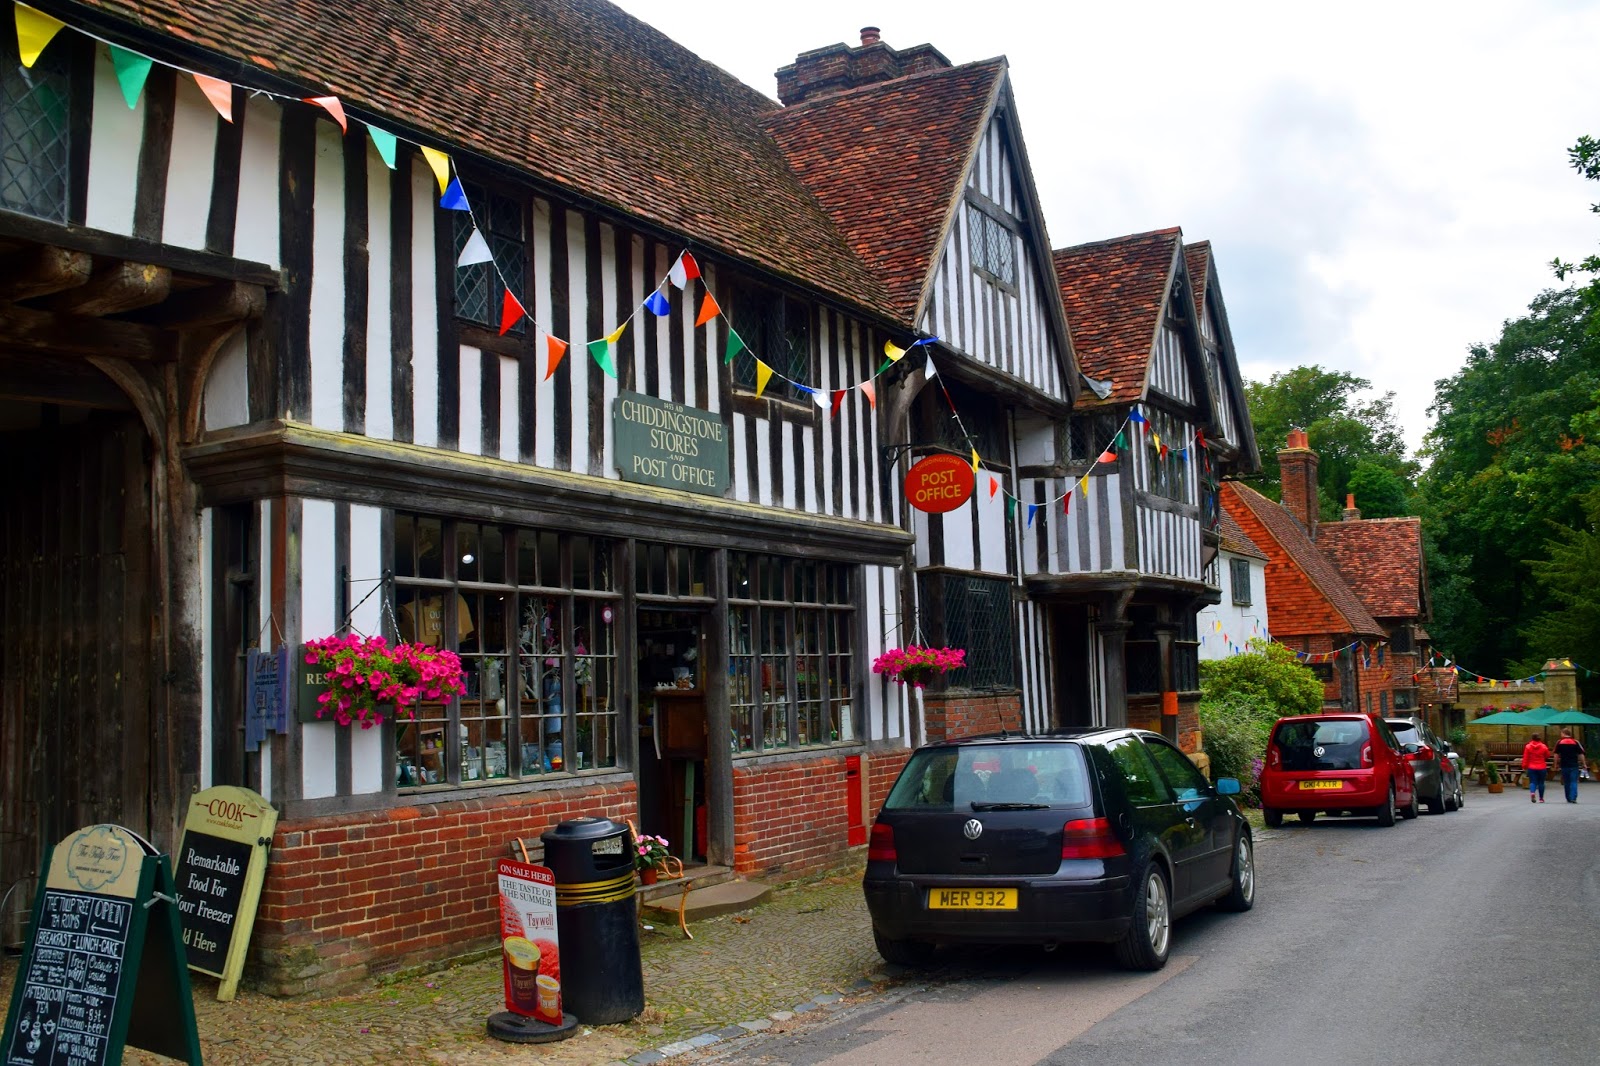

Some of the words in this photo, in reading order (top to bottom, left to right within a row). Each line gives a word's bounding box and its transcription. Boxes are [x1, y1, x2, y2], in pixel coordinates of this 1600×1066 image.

[622, 400, 722, 442] CHIDDINGSTONE
[650, 428, 698, 456] STORES
[633, 455, 667, 478] POST
[672, 464, 716, 487] OFFICE
[916, 456, 960, 472] CHIDDINGSTONE
[921, 470, 956, 486] POST
[916, 484, 962, 502] OFFICE
[306, 673, 330, 684] RES
[209, 798, 246, 822] COOK
[186, 848, 240, 876] Remarkable
[500, 864, 512, 874] ON
[512, 866, 530, 878] SALE
[531, 870, 552, 883] HERE
[188, 872, 210, 892] Food
[211, 878, 227, 898] For
[501, 879, 517, 890] THE
[518, 883, 540, 896] TASTE
[542, 888, 553, 898] OF
[47, 896, 59, 911] THE
[503, 888, 518, 900] THE
[520, 892, 552, 907] SUMMER
[940, 892, 970, 906] MER
[975, 891, 1006, 906] 932
[94, 900, 125, 927] OPEN
[175, 893, 195, 914] Your
[197, 900, 233, 925] Freezer
[527, 913, 553, 929] Taywell
[38, 931, 72, 948] BREAKFAST
[182, 928, 191, 945] ld
[193, 931, 216, 952] Here
[25, 986, 65, 1001] AFTERNOON
[36, 1001, 48, 1014] TEA
[84, 1035, 100, 1048] TART
[70, 1044, 98, 1062] SAUSAGE
